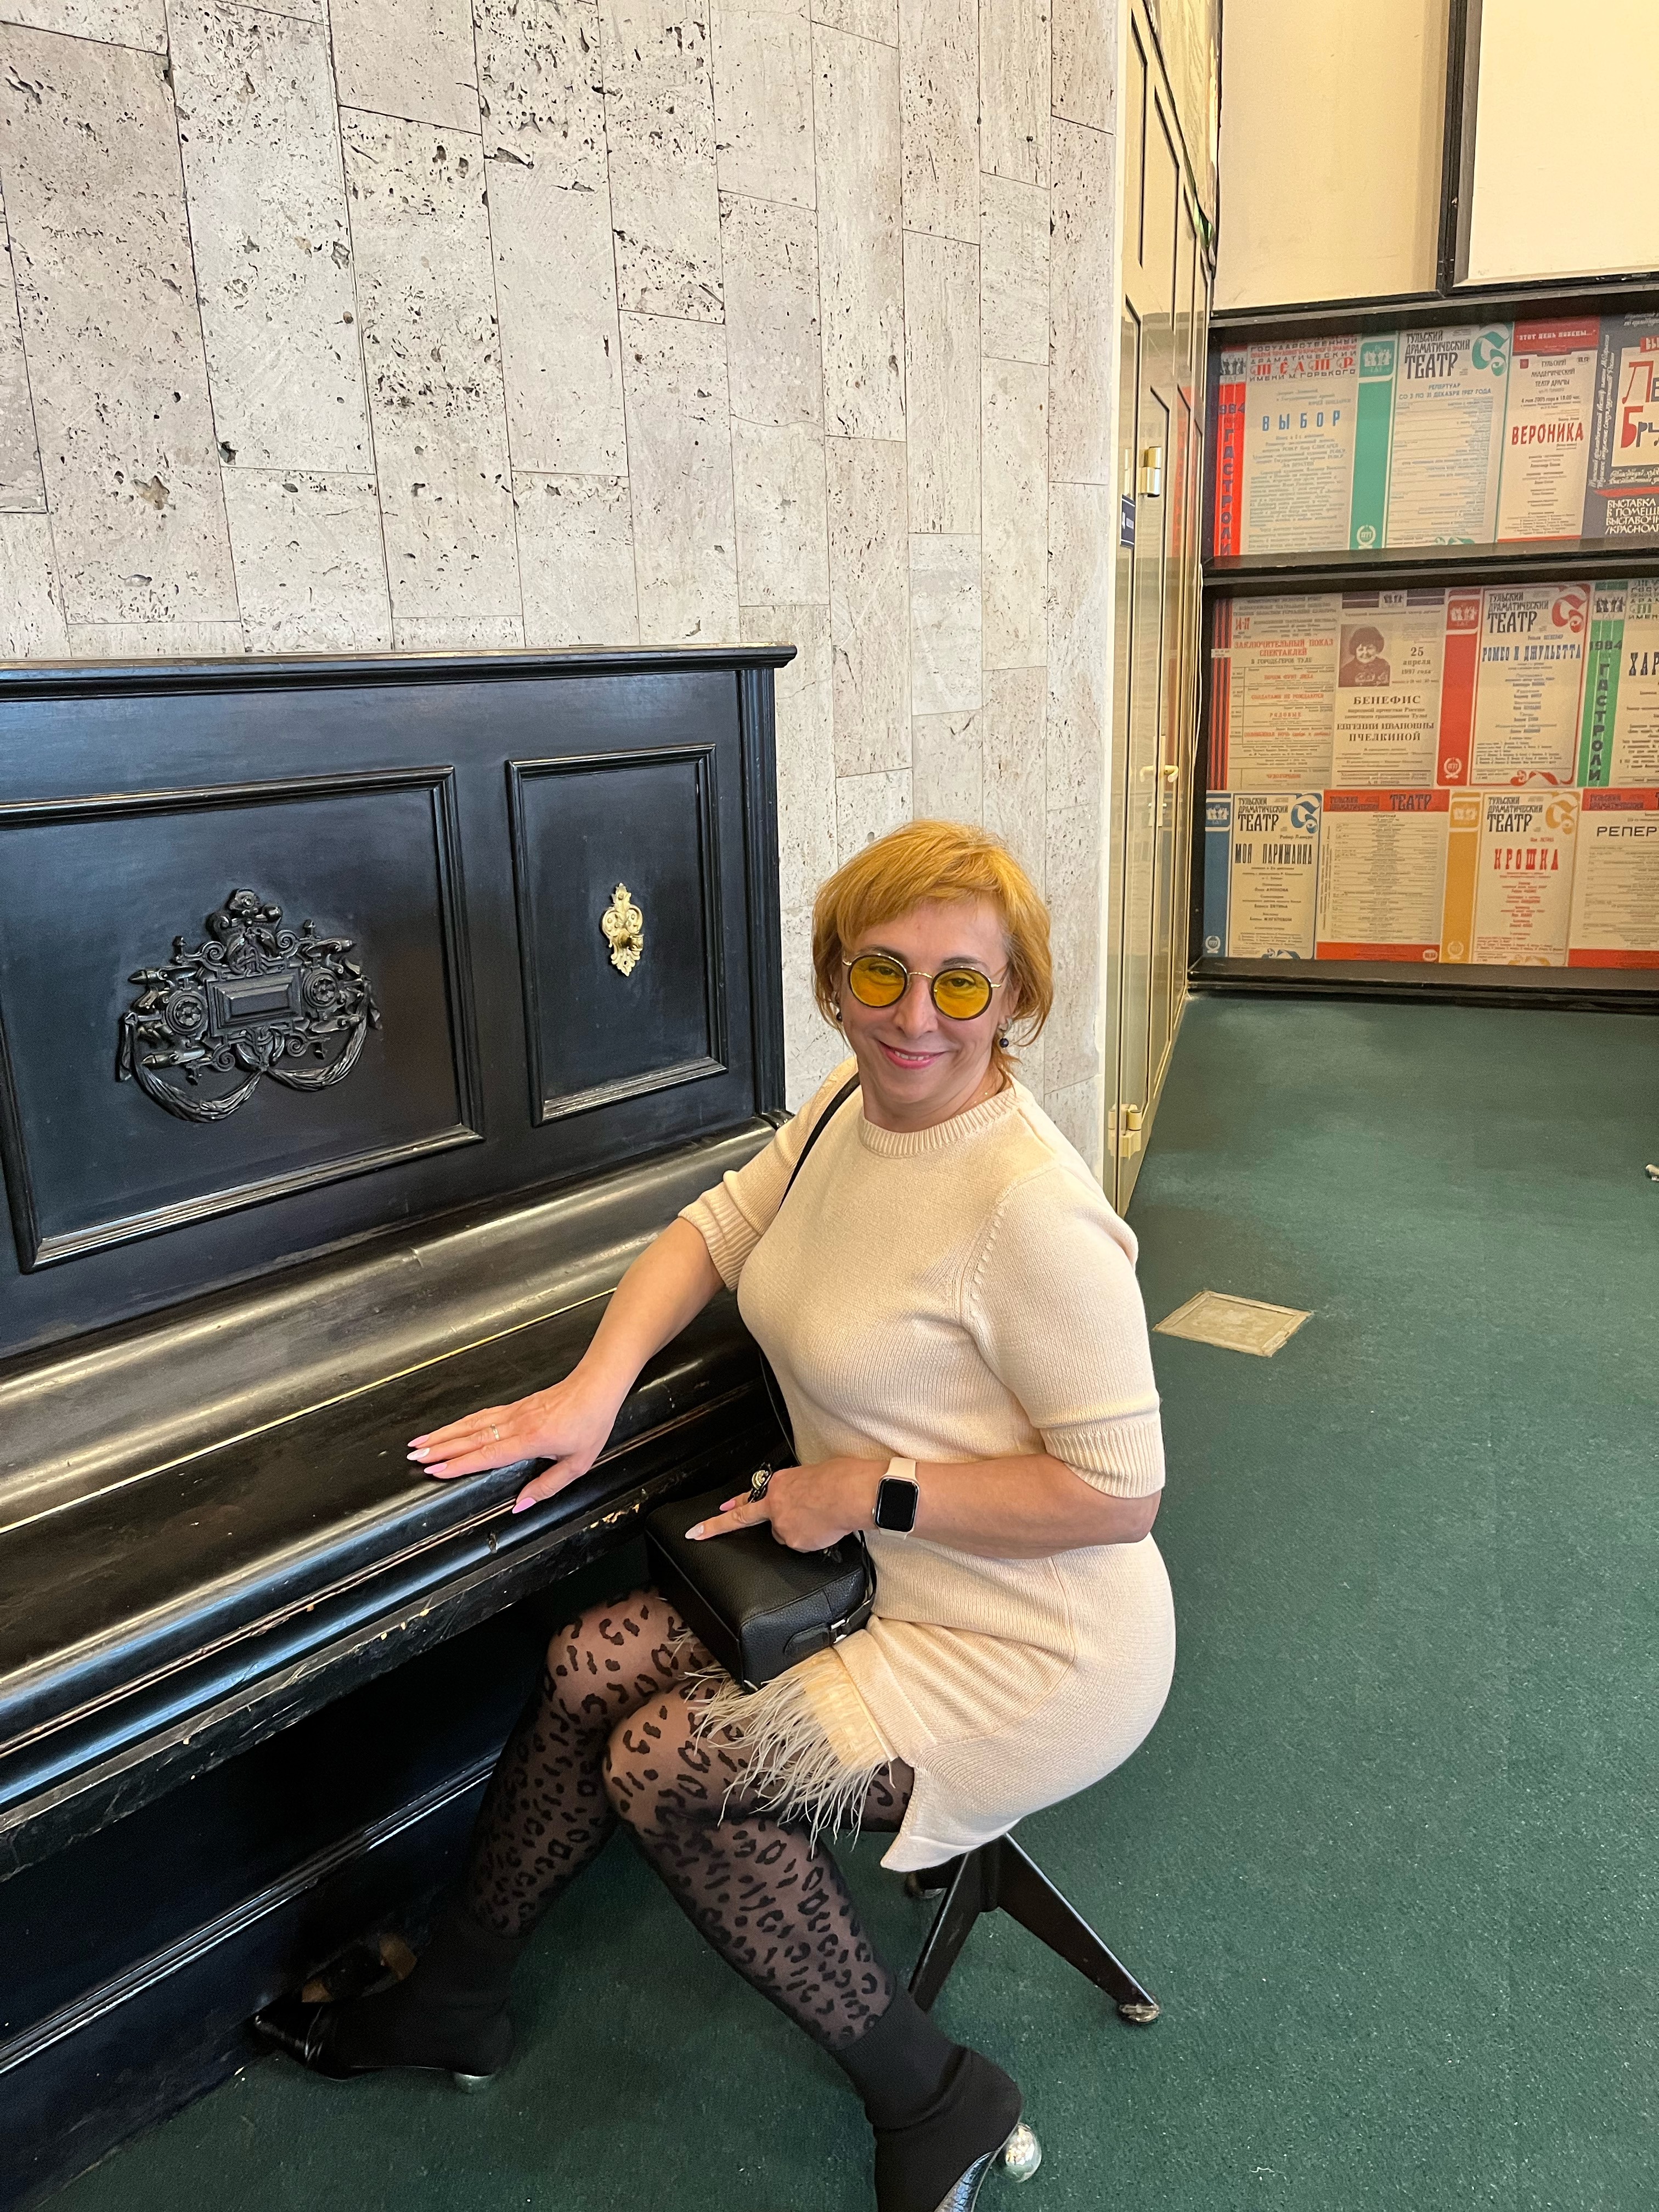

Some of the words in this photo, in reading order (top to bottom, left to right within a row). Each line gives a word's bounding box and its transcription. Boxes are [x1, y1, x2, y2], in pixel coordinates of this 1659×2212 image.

[1406, 339, 1471, 356] ДРАМАТИЧЕСКИЙ
[1404, 352, 1458, 380] ТЕАТР
[1262, 410, 1340, 431] ВЫБОР
[1511, 421, 1584, 445] ВЕРОНИКА
[1221, 428, 1234, 555] ГАСТРОЛИ
[1607, 498, 1656, 509] ВЫСТАВКА
[1487, 611, 1538, 634] ТЕАТР
[1309, 638, 1334, 647] ПОКАЗ
[1410, 646, 1424, 657] 25
[1260, 647, 1307, 657] СПЕКТАКЛЕЙ
[1482, 646, 1510, 662] РОМЕО
[1514, 646, 1520, 661] И
[1524, 644, 1581, 662] ДЖУЛЬЕТТА
[1353, 695, 1421, 705] БЕНЕФИС
[1588, 663, 1610, 781] ГАСТРОЛИ
[1349, 731, 1421, 742] ПЧЕЛКИНОЙ
[1238, 804, 1289, 814] ДРАМАТИЧЕСКИЙ
[1390, 794, 1432, 811] ТЕАТР
[1238, 813, 1279, 832] ТЕАТР
[1487, 814, 1533, 833] ТЕАТР
[1596, 826, 1657, 837] РЕПЕР
[1235, 843, 1252, 864] МОЯ
[1262, 843, 1312, 865] ПАРИЖАНКА
[1493, 848, 1559, 871] КРОШКА
